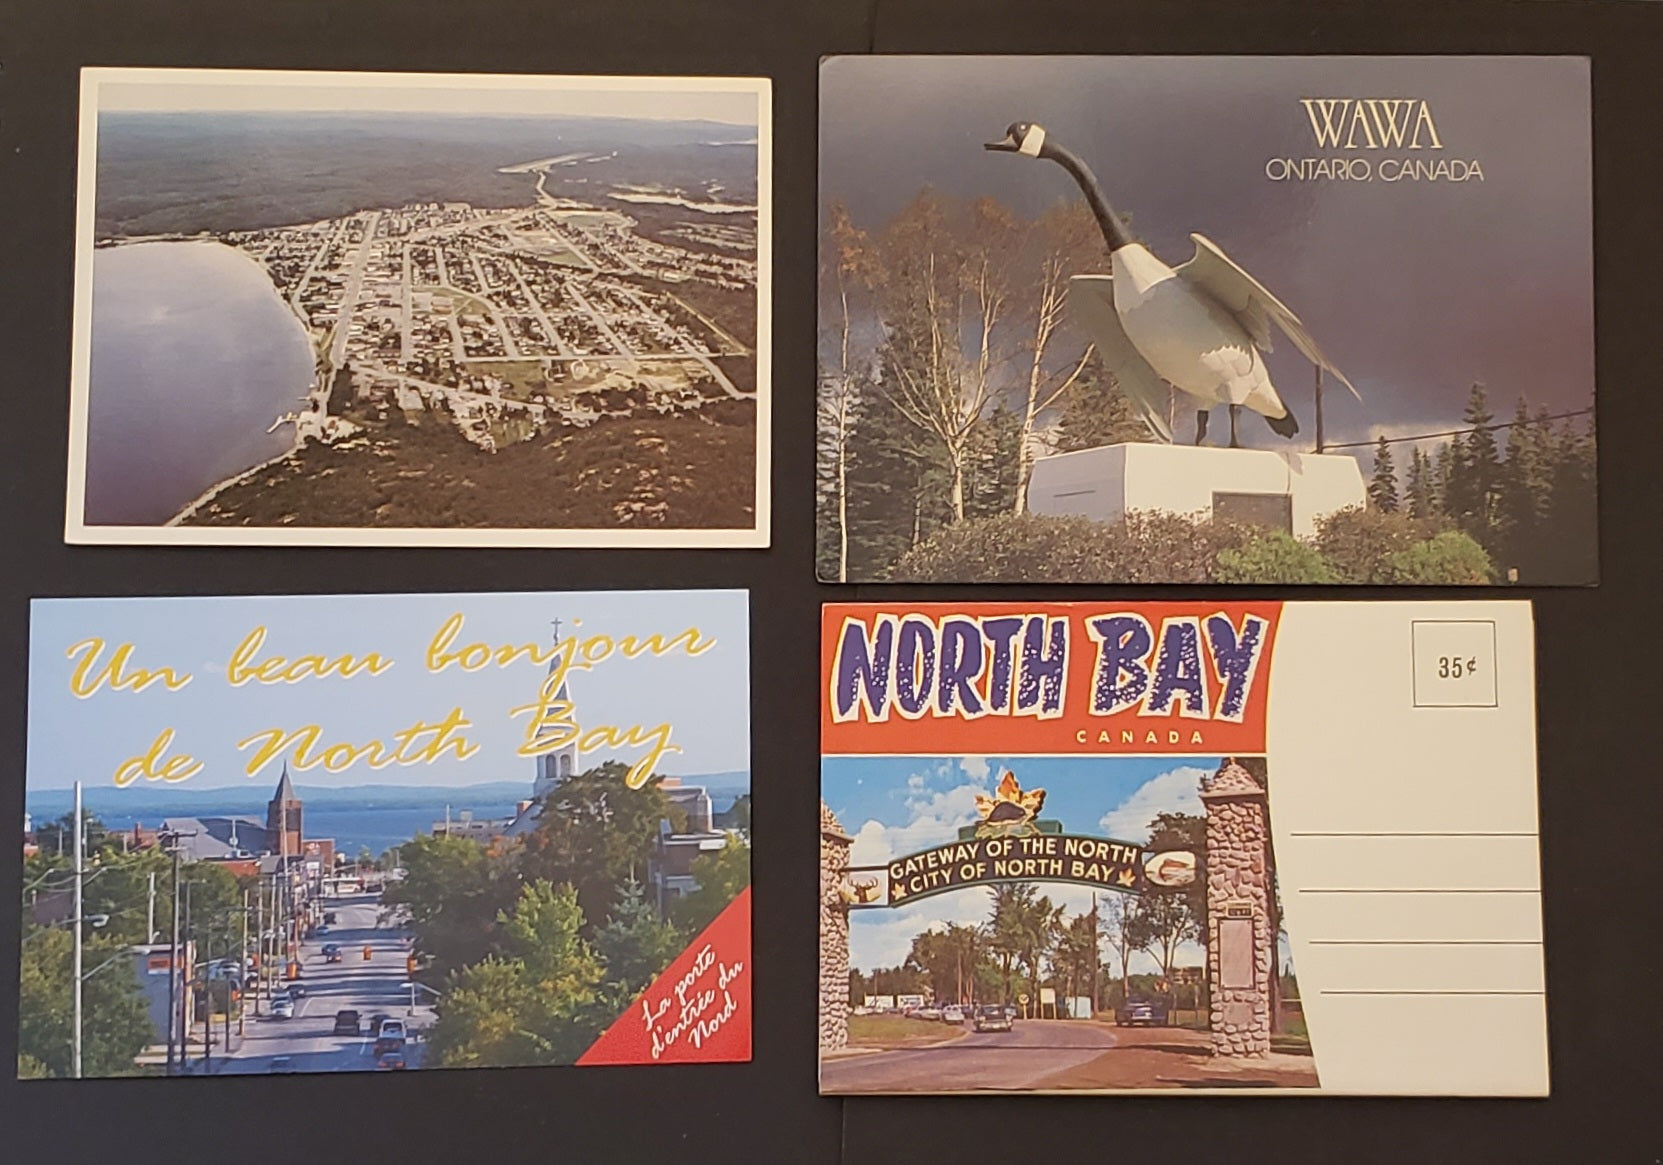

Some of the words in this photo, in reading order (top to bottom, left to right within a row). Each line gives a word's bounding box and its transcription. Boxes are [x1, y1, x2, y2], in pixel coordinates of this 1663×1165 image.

[1300, 99, 1443, 149] WAWA
[1265, 158, 1373, 182] ONTARIO,
[1378, 159, 1485, 182] CANADA
[66, 637, 193, 699] Un
[227, 625, 394, 687] beau
[426, 612, 717, 702] bonjour
[831, 613, 1069, 723] NORTH
[1085, 612, 1270, 723] BAY
[1438, 656, 1477, 678] 35¢
[113, 728, 204, 788] de
[237, 707, 480, 777] North
[509, 700, 683, 790] Bay
[1076, 729, 1203, 744] CANADA
[890, 842, 979, 880] GATEWAY
[985, 839, 1013, 857] OF
[1019, 838, 1057, 855] THE
[1064, 839, 1138, 866] NORTH
[910, 865, 954, 893] CITY
[960, 862, 987, 880] OF
[994, 859, 1063, 878] NORTH
[1071, 861, 1115, 883] BAY
[642, 998, 671, 1031] La
[674, 944, 715, 1006] porte
[652, 990, 715, 1060] d'entrée
[719, 962, 743, 990] du
[688, 991, 737, 1049] Nord
